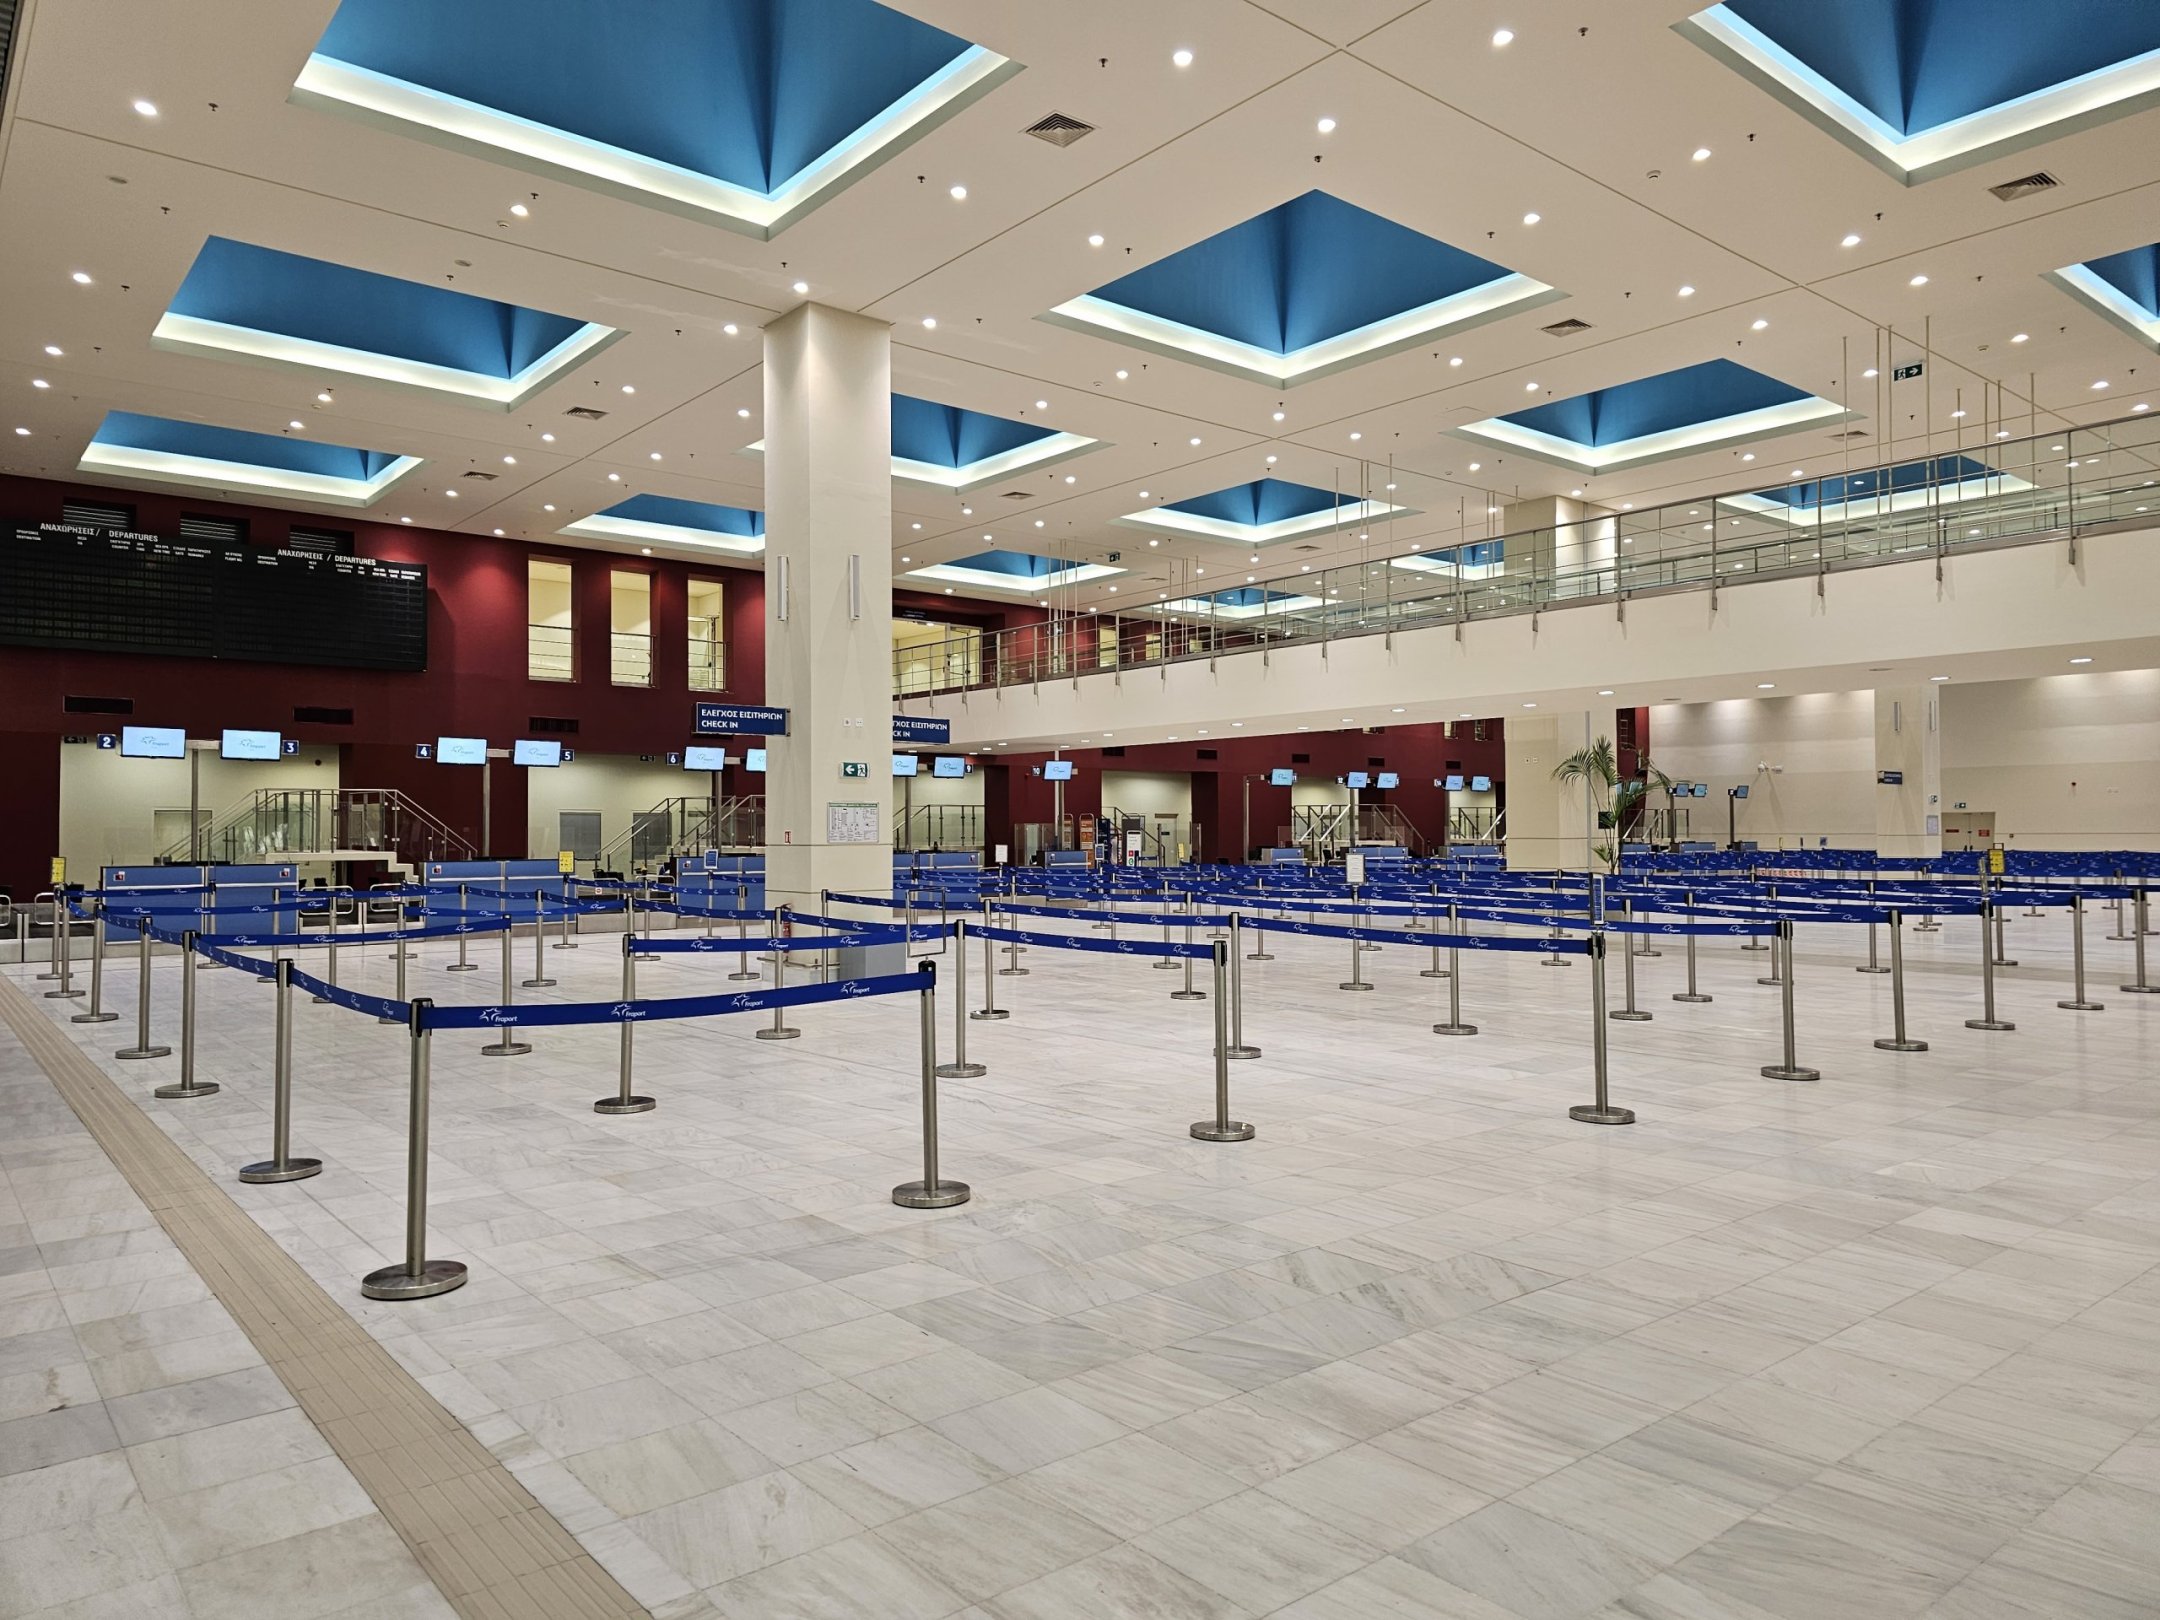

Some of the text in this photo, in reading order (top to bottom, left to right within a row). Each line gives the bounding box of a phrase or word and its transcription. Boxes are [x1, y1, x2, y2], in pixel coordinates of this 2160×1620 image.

[40, 523, 95, 535] ΑΝΑΧΩΡΗΣΕΙΣ
[109, 530, 159, 542] DEPARTURES
[277, 549, 324, 560] ΑΝΑΧΩΡΗΣΕΙΣ
[334, 555, 376, 566] DEPARTURES
[701, 708, 783, 720] ΕΛΕΓΧΟΣ ΕΙΣΙΤΗΡΙΩΝ
[701, 720, 738, 729] CHECK IN
[102, 736, 111, 748] 2
[287, 742, 295, 753] 3
[420, 747, 428, 757] 4
[564, 751, 571, 761] 5
[670, 755, 676, 764] 6
[966, 765, 971, 773] 9
[626, 1010, 646, 1018] Fraport
[495, 1015, 518, 1024] Fraport
